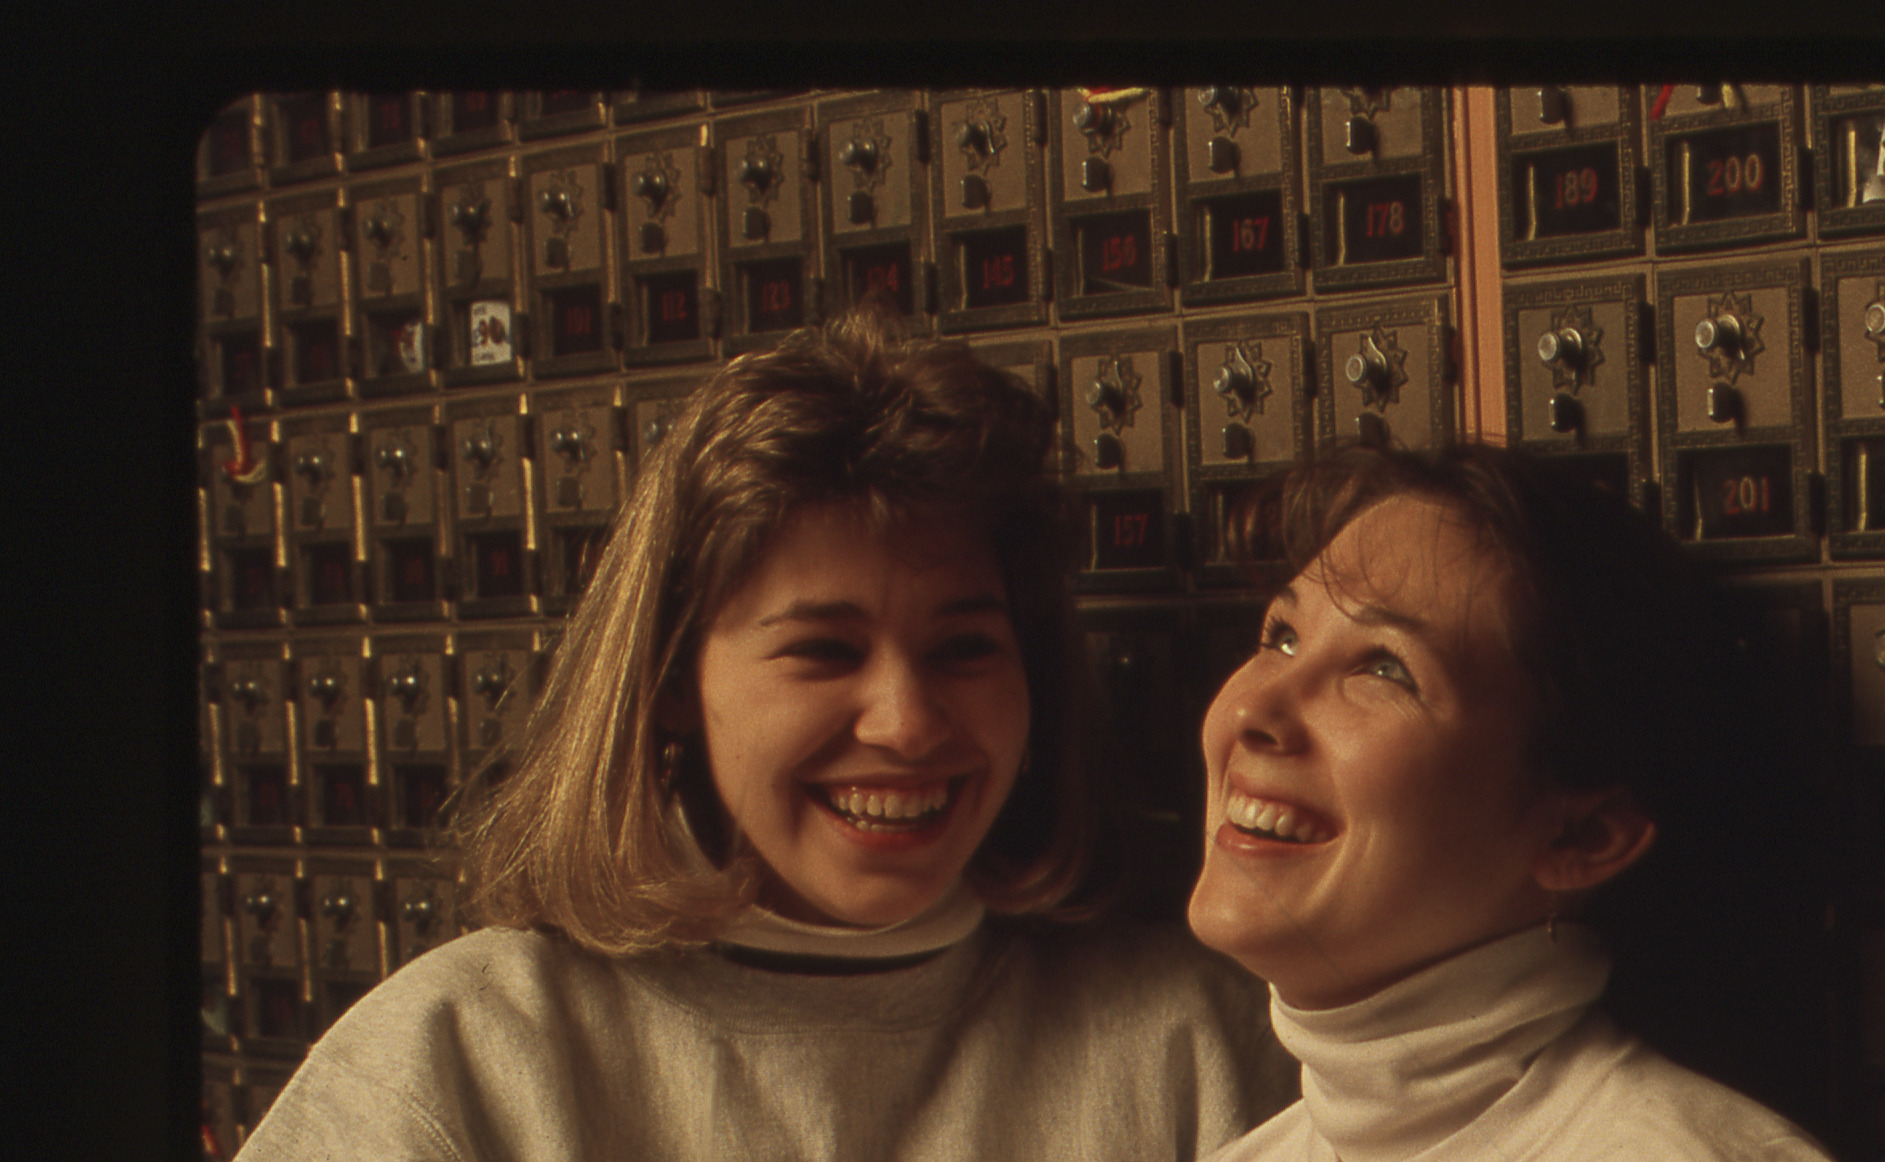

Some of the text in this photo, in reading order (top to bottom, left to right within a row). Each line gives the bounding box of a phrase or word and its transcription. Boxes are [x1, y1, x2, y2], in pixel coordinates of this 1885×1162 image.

[1556, 169, 1598, 208] 189
[1708, 153, 1763, 195] 200
[1232, 217, 1269, 251] 167
[1366, 201, 1404, 237] 178
[763, 281, 791, 311] 123
[1723, 477, 1770, 515] 201
[1114, 513, 1147, 545] 157
